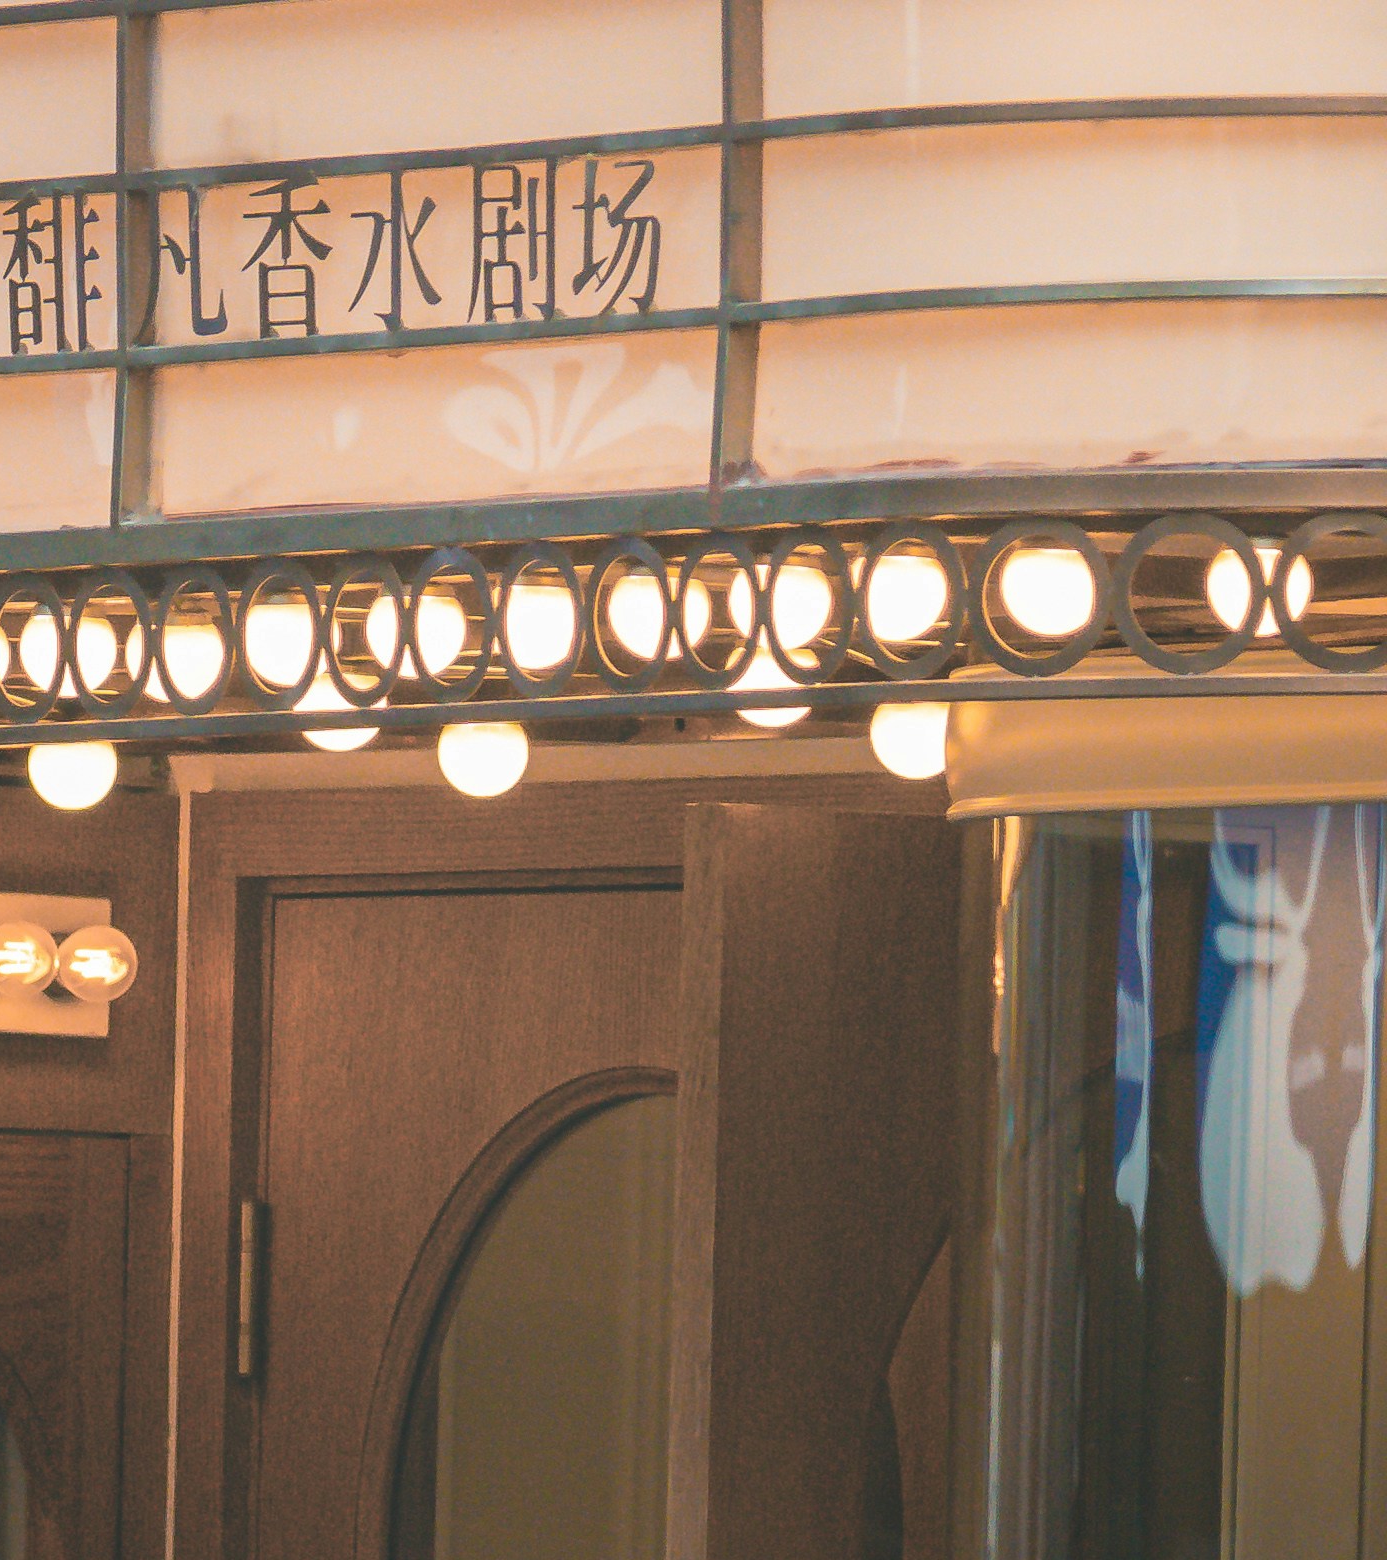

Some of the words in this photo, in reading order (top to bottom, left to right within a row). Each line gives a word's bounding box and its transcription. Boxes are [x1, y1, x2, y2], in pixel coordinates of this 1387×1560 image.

[1, 158, 661, 354] 馡凡香水剧场
